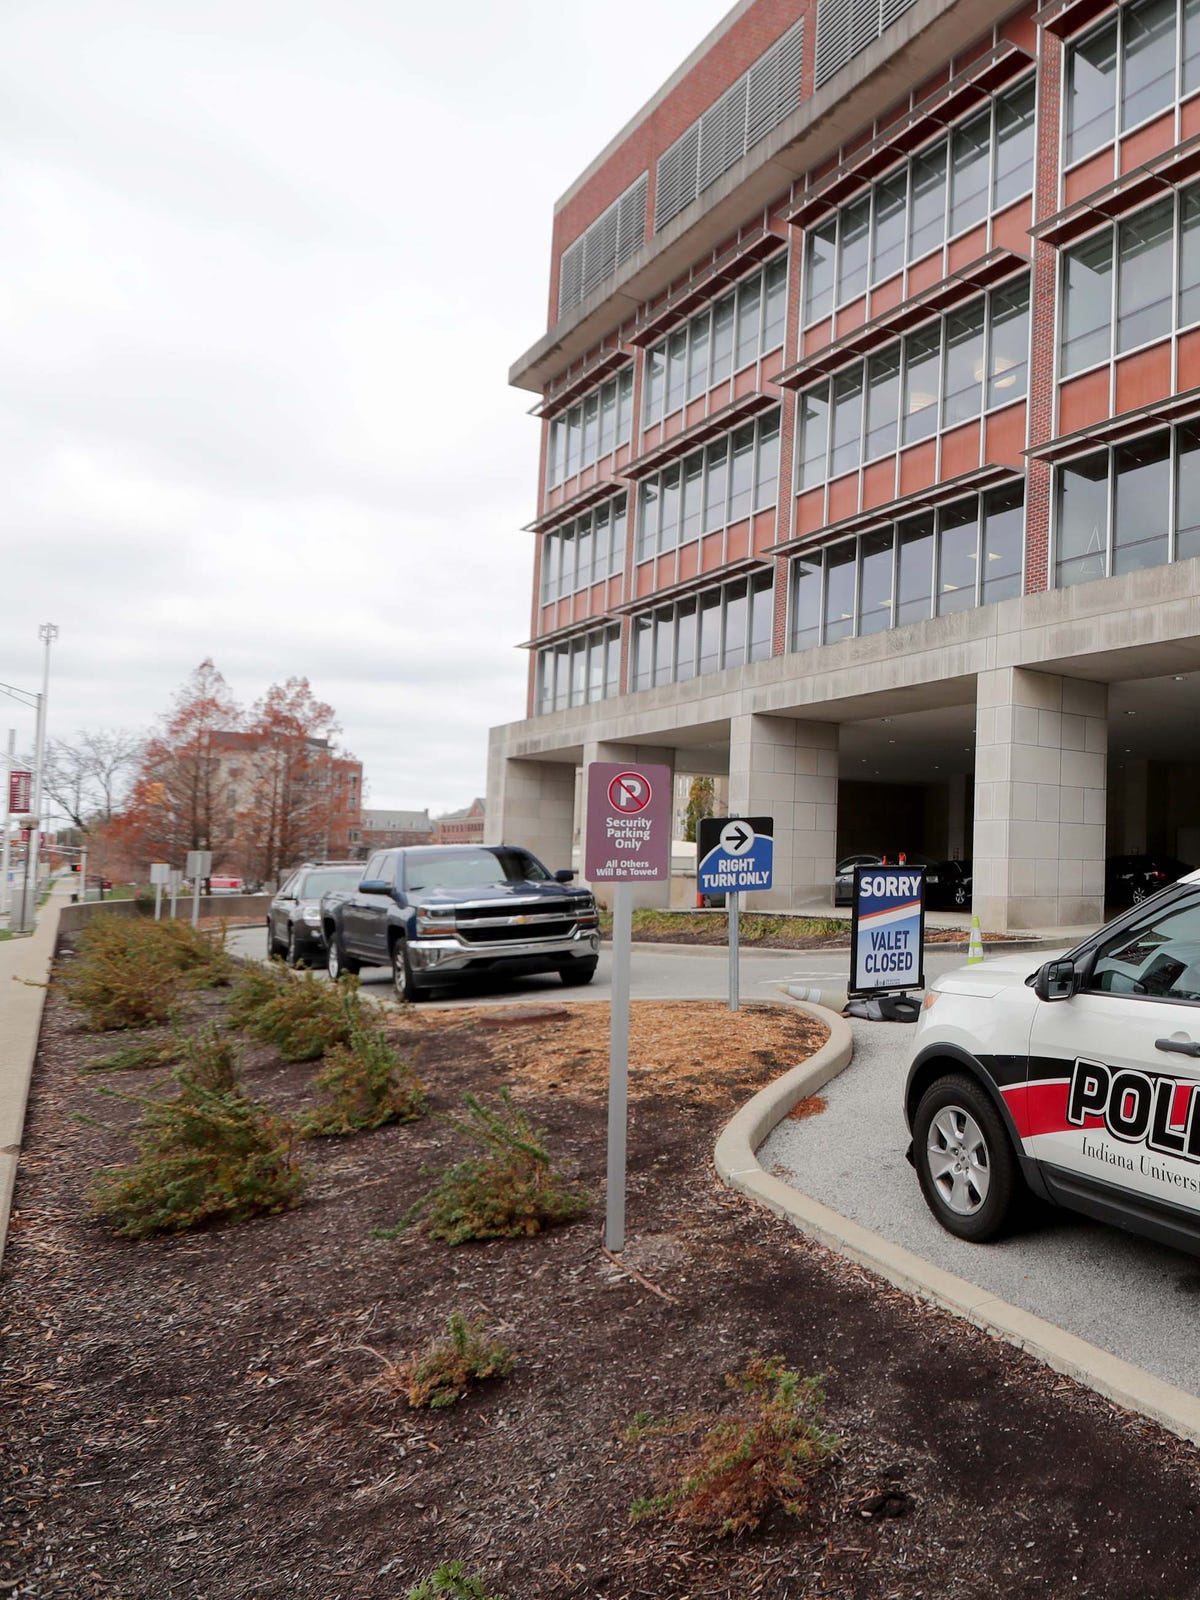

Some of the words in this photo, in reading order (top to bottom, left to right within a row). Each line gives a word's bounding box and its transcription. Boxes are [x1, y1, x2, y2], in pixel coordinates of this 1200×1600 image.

[606, 817, 652, 830] Security
[607, 828, 650, 841] Parking
[615, 839, 642, 851] Only
[596, 868, 614, 876] Will
[616, 868, 628, 876] Be
[630, 867, 658, 876] Towed
[606, 860, 618, 868] All
[620, 860, 649, 868] Others
[718, 858, 755, 873] RIGHT
[702, 873, 736, 888] TURN
[738, 871, 770, 886] ONLY
[859, 876, 922, 898] SORRY
[870, 930, 910, 951] VALET
[865, 952, 913, 974] CLOSED
[1081, 1136, 1135, 1171] Indiana
